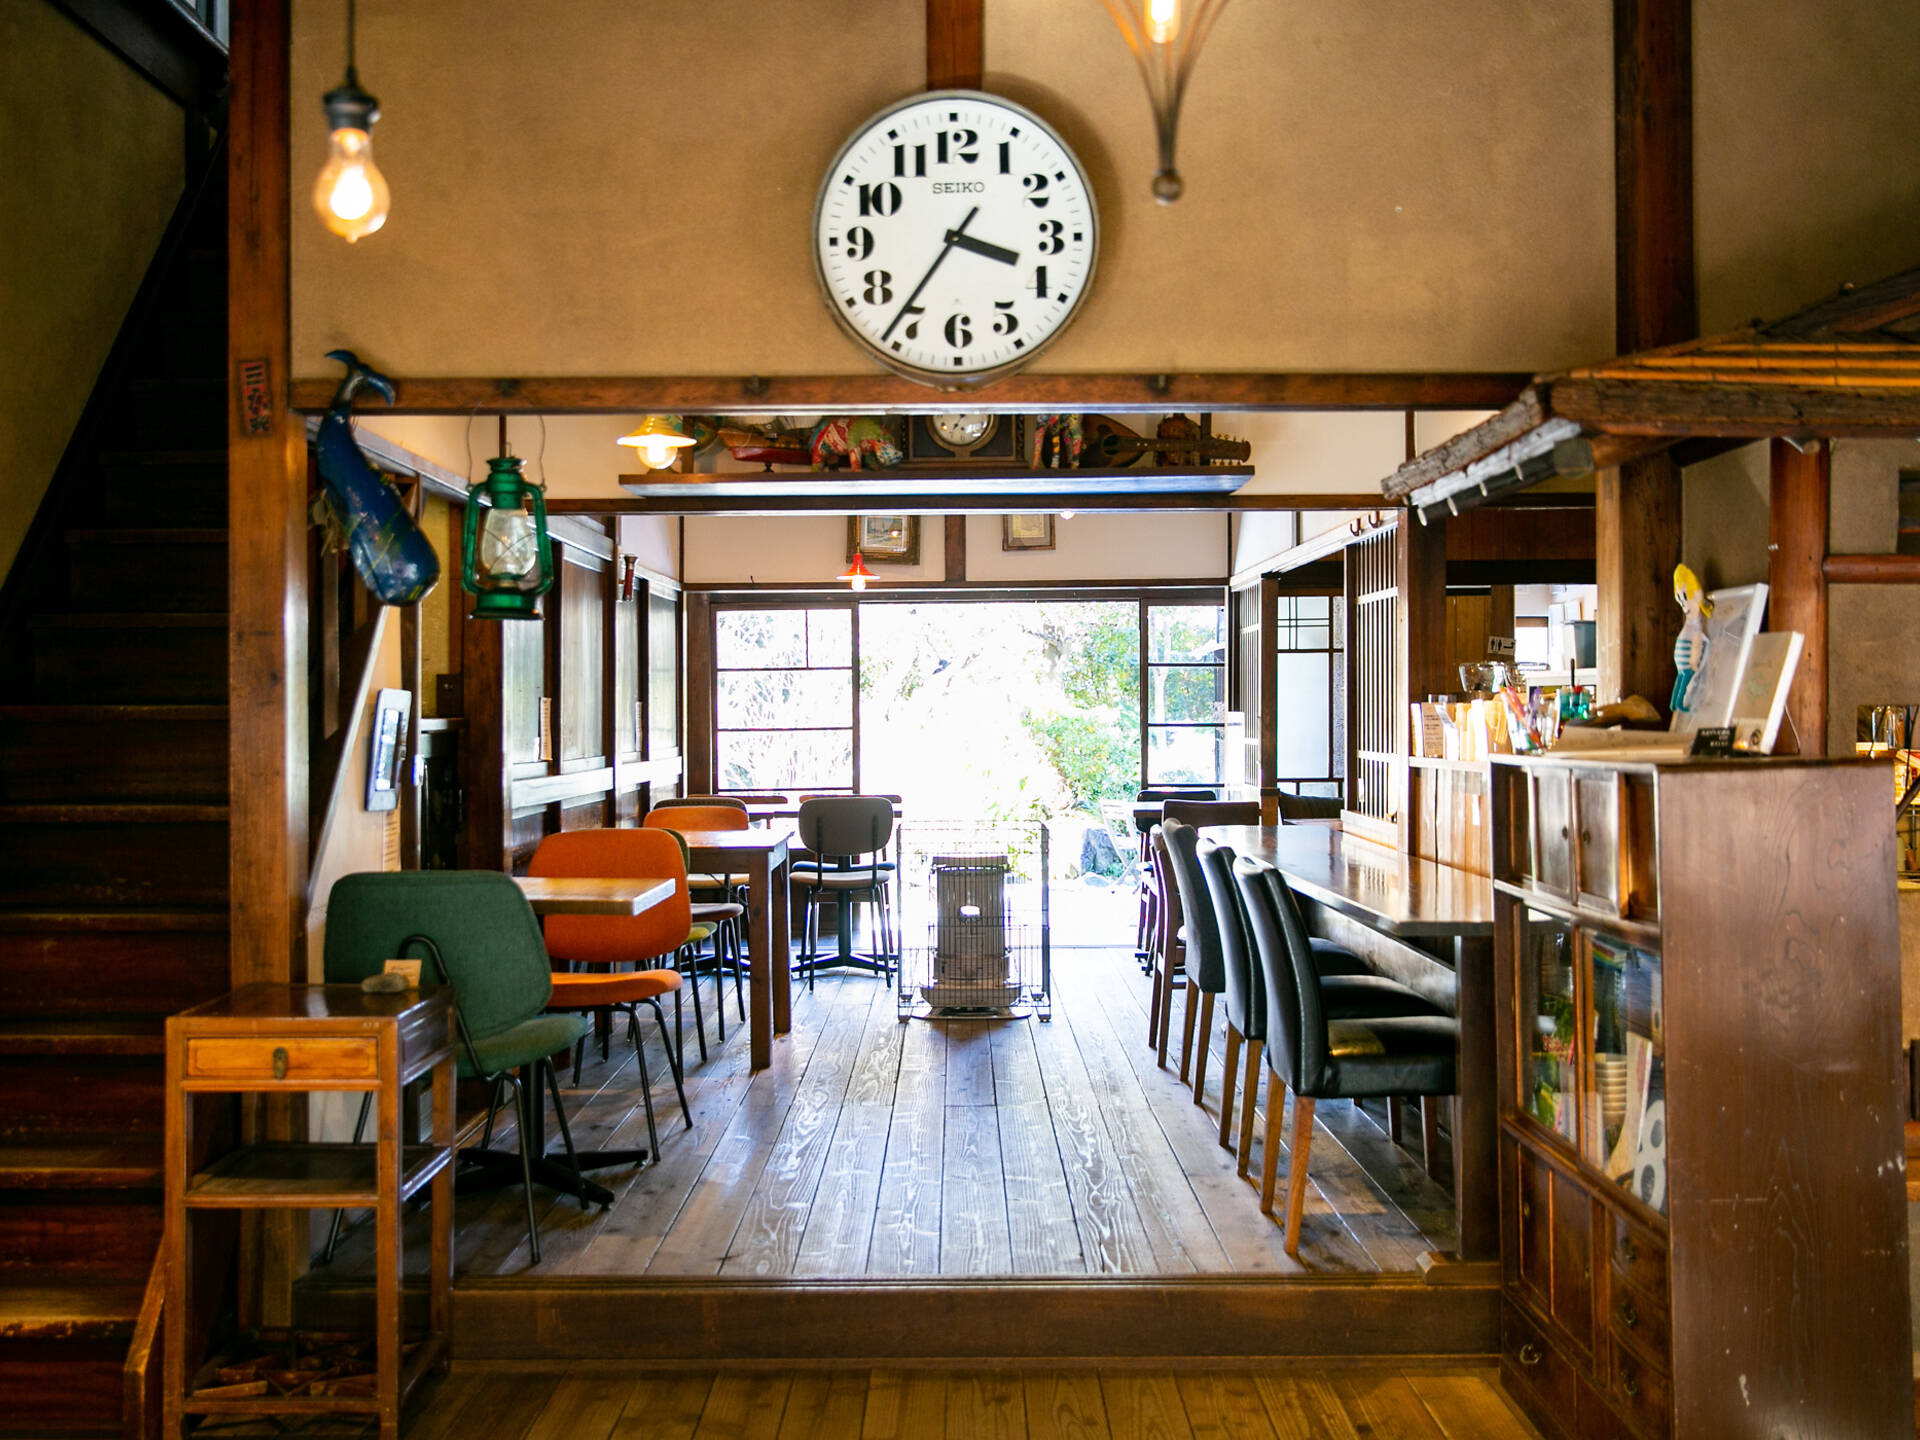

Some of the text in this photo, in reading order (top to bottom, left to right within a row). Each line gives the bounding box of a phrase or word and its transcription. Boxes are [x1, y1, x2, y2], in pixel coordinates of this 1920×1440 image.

[893, 144, 930, 178] 11
[935, 129, 979, 164] 12
[998, 142, 1013, 175] 1
[858, 182, 903, 217] 10
[932, 182, 985, 194] SEIKO
[1022, 173, 1050, 208] 2
[847, 226, 874, 261] 9
[1039, 219, 1064, 255] 3
[863, 270, 893, 305] 8
[1026, 266, 1052, 298] 4
[902, 304, 925, 340] 7
[944, 313, 973, 348] 6
[993, 300, 1018, 336] 5
